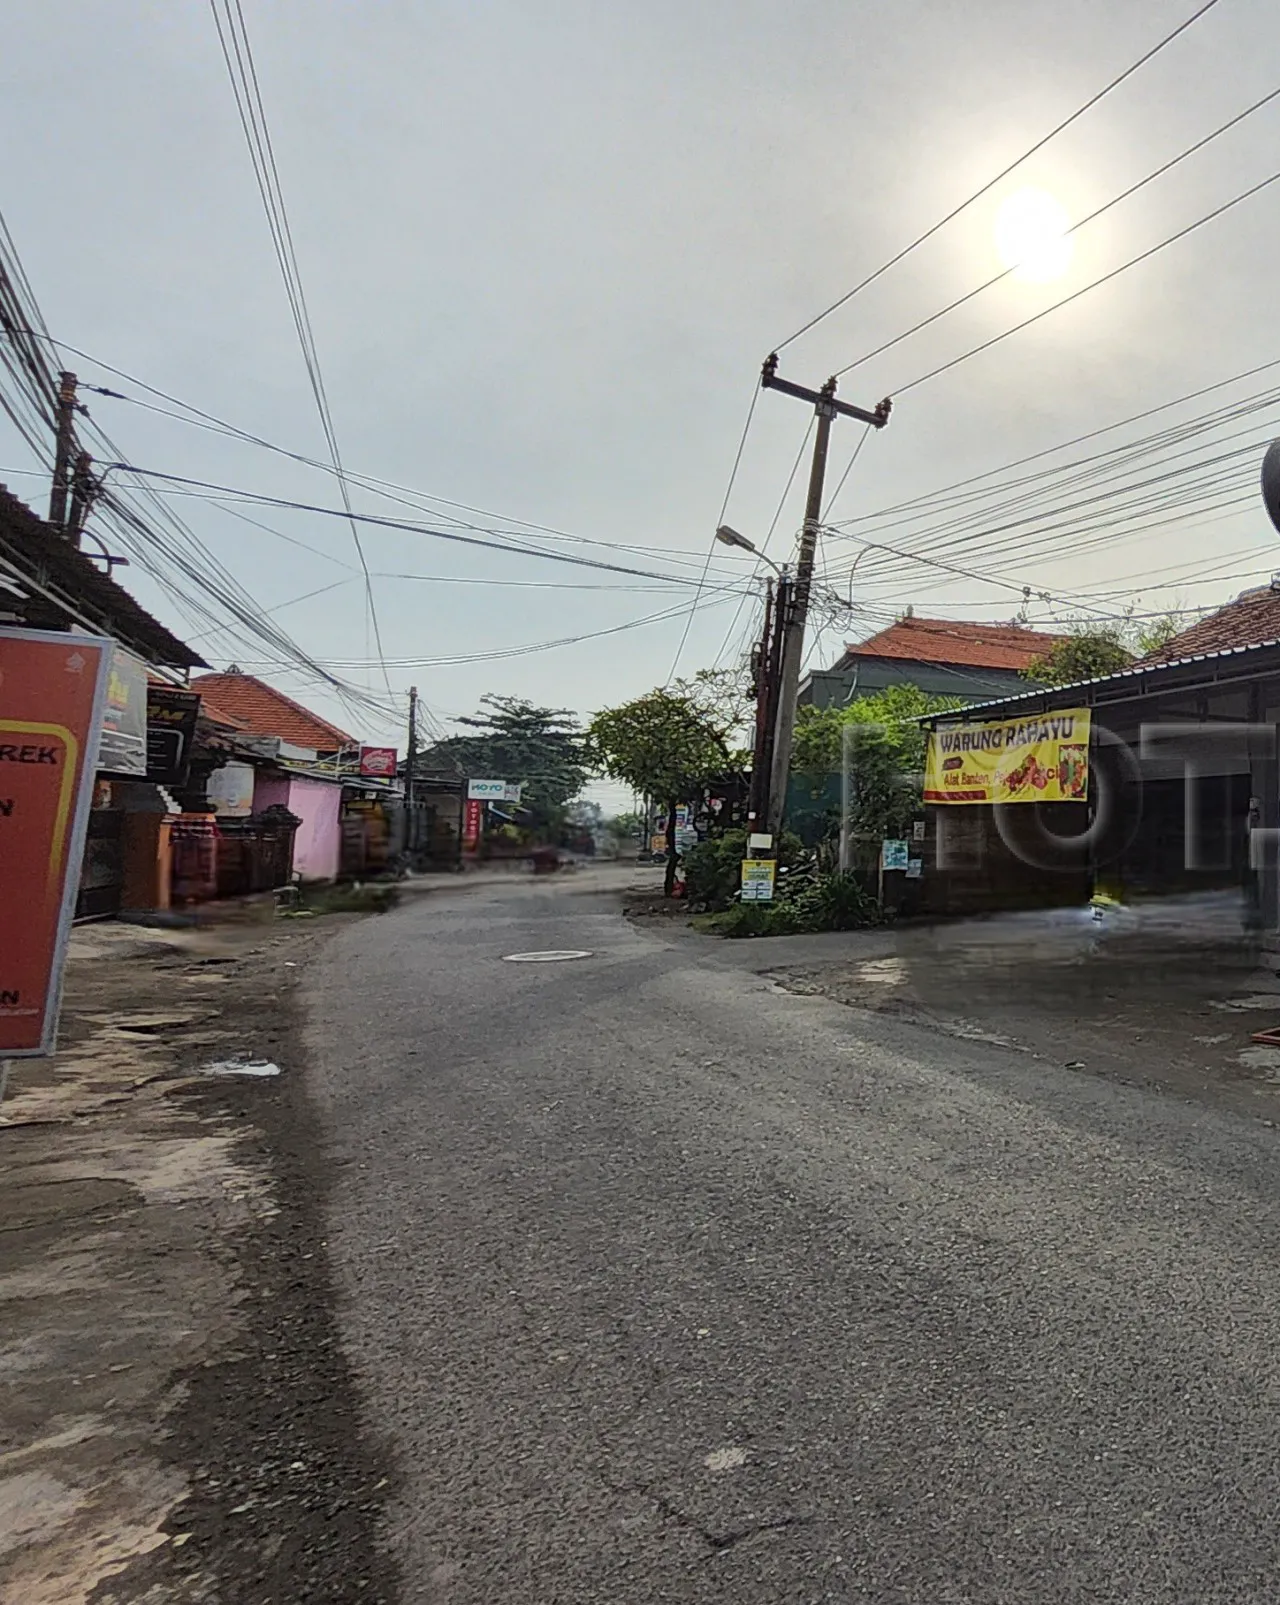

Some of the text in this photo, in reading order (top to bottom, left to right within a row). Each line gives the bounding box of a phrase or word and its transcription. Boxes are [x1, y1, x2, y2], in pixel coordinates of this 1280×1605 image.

[940, 716, 1074, 753] WARUNG RAHAYU
[943, 772, 960, 786] Alat
